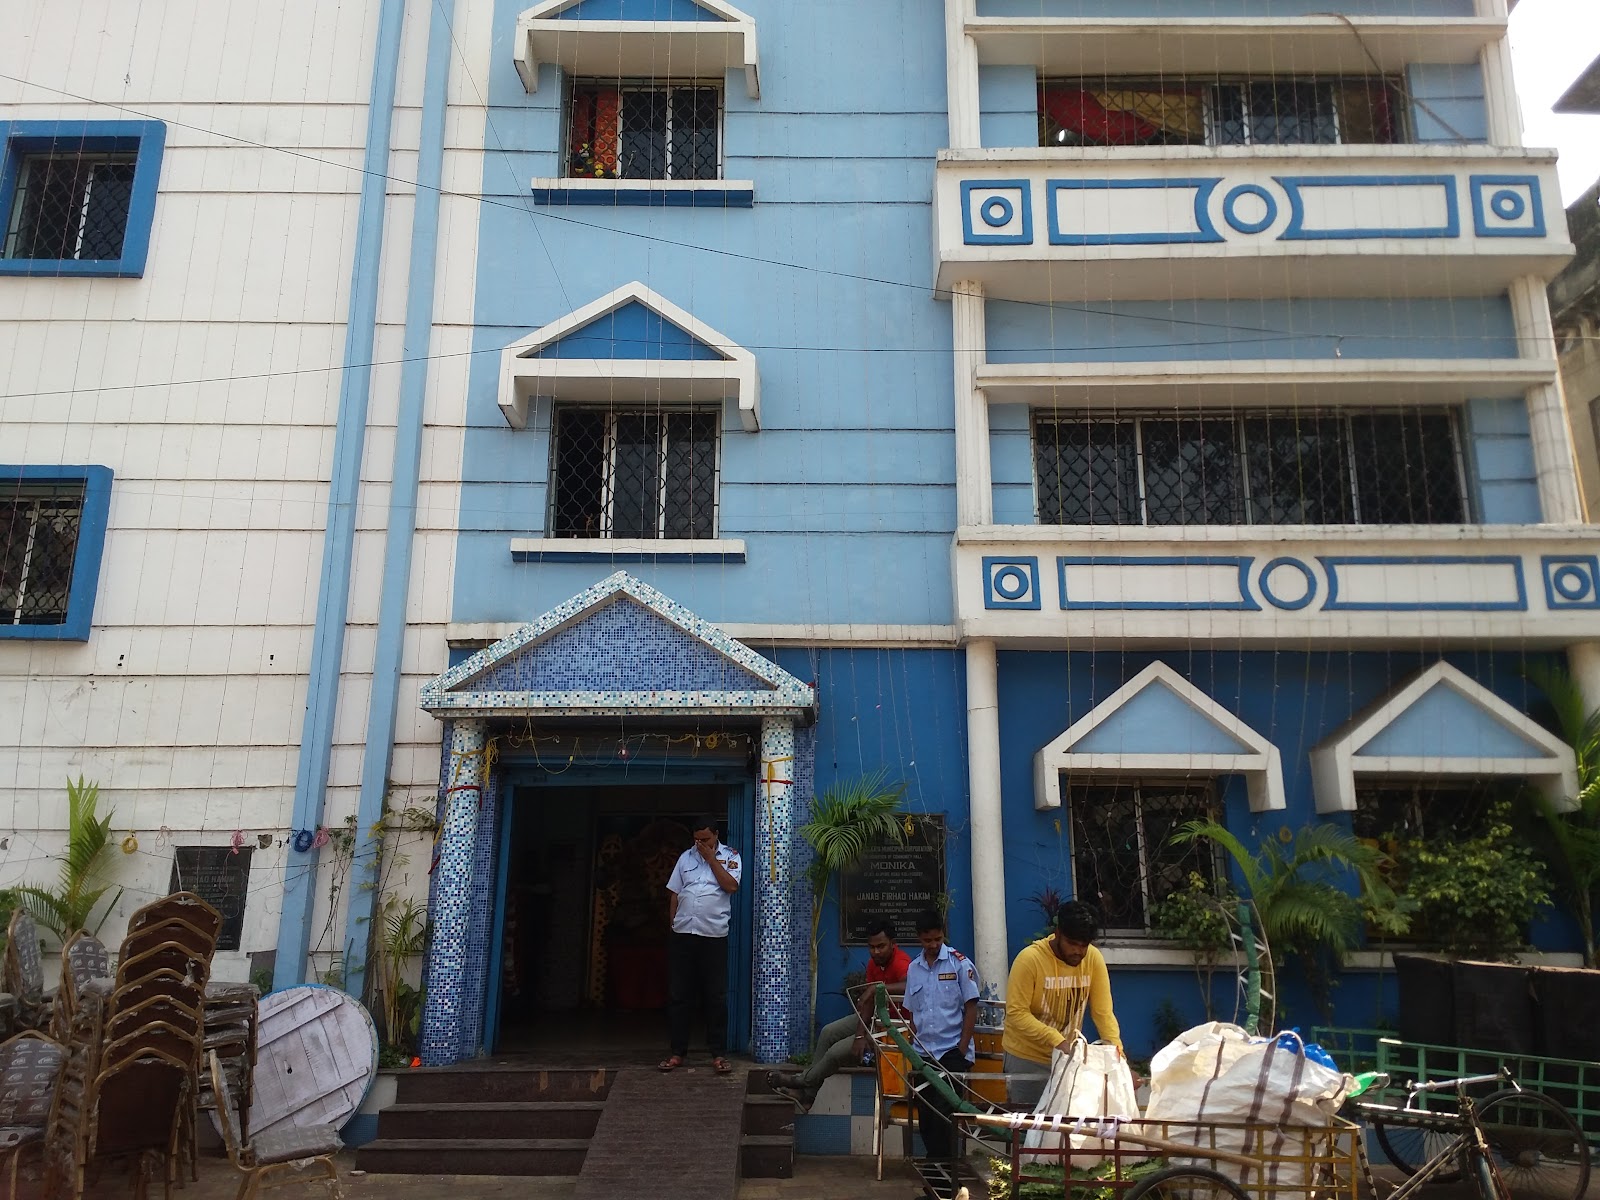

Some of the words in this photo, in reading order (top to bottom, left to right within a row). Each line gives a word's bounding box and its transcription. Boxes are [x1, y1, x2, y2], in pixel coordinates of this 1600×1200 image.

[870, 861, 916, 870] MONIKA
[856, 892, 880, 901] JANAB
[908, 892, 931, 901] HAKIM
